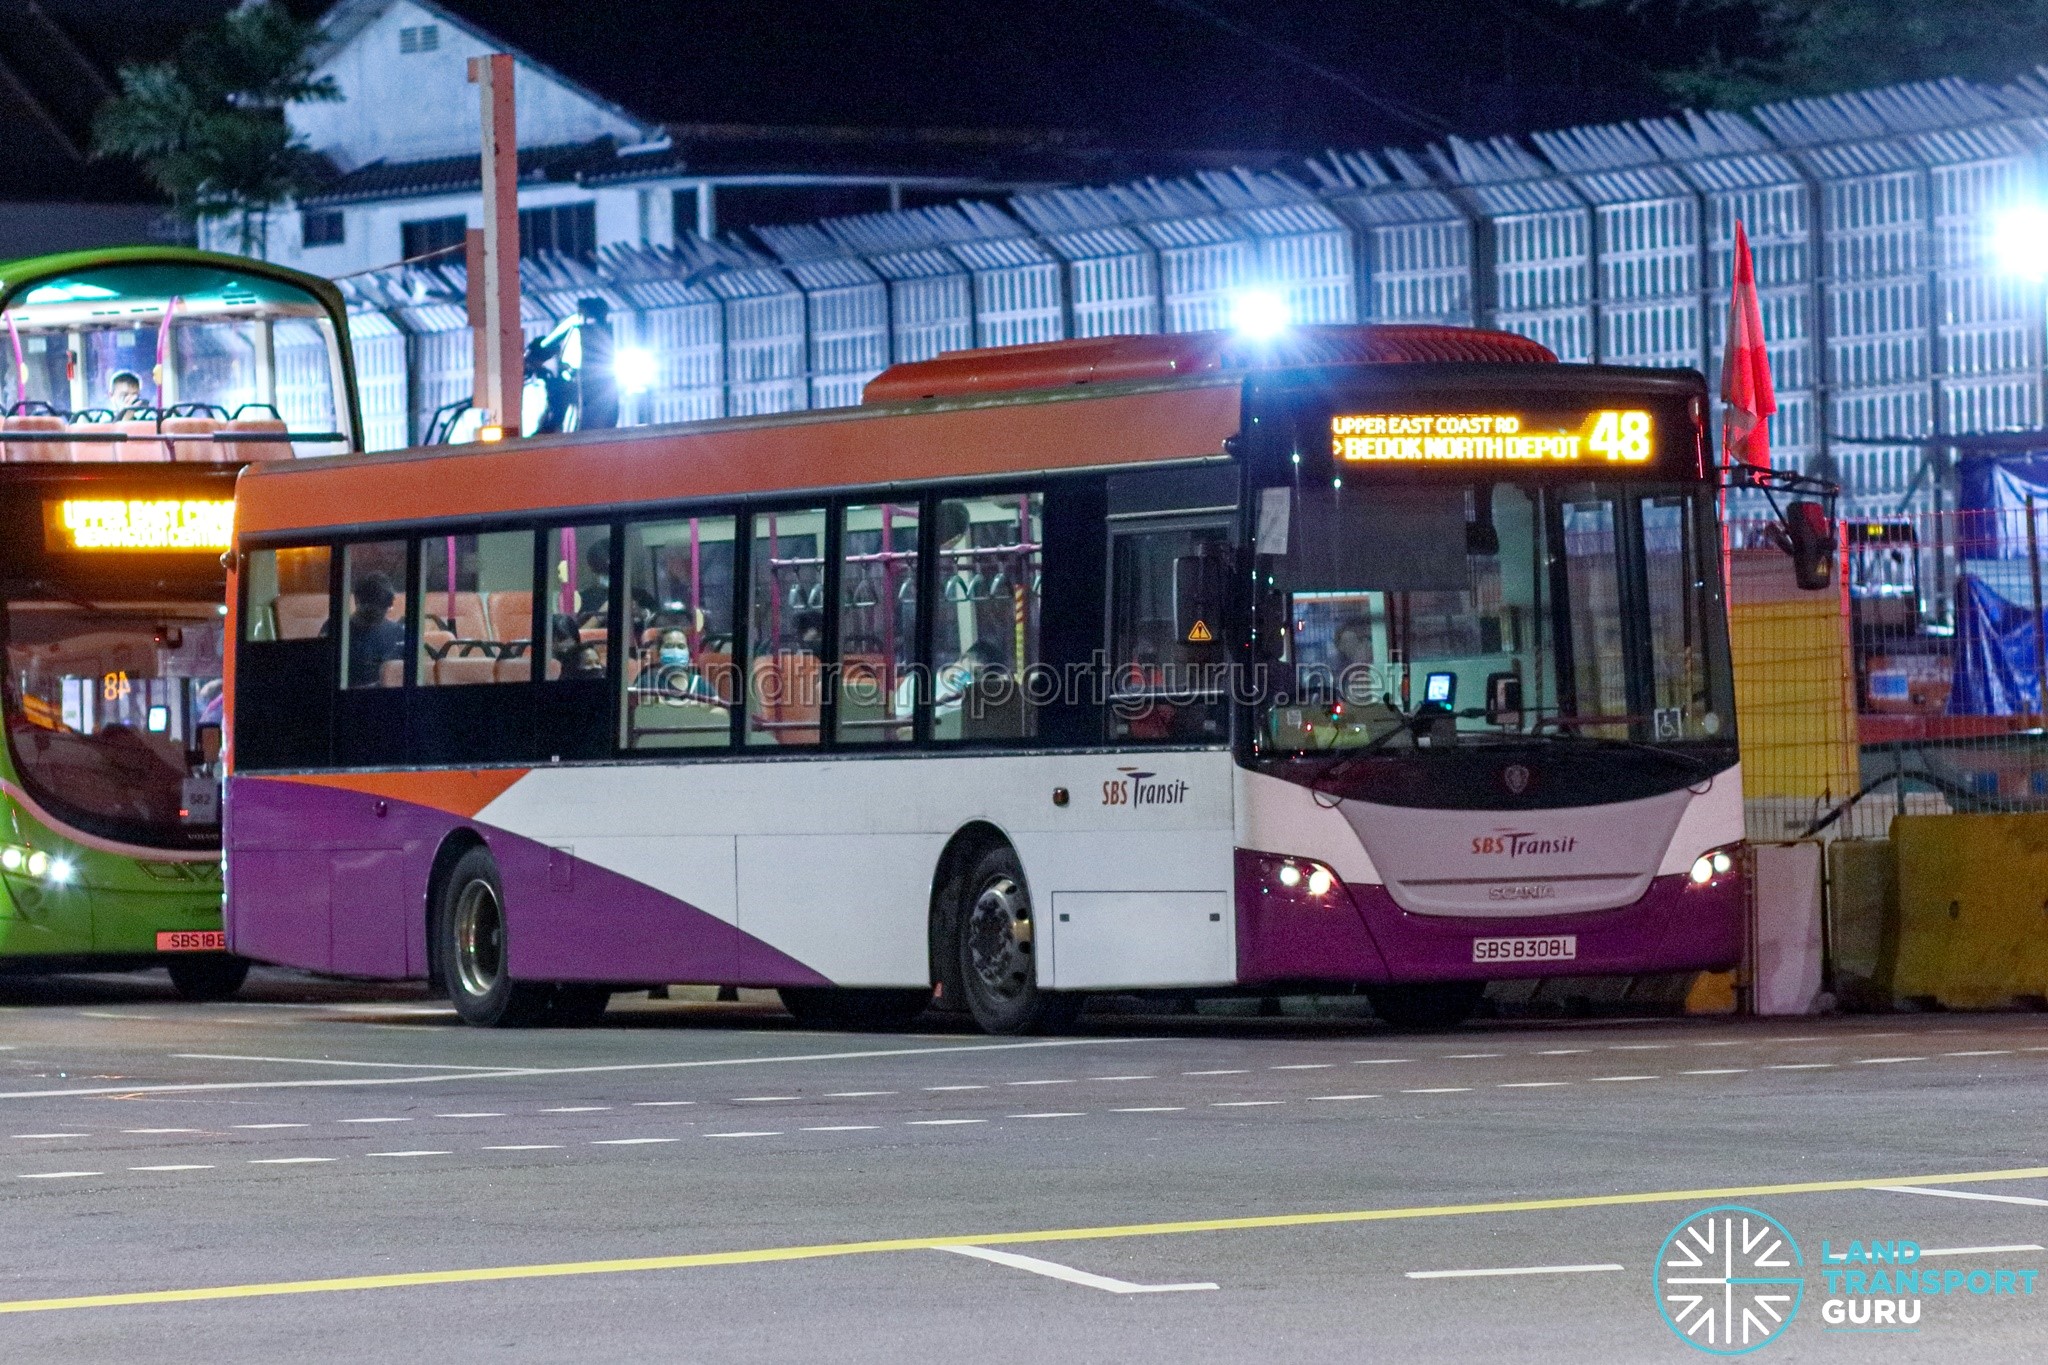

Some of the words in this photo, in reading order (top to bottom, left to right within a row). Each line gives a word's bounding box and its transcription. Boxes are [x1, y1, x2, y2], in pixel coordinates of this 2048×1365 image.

[1332, 416, 1386, 434] UPPER
[1388, 416, 1434, 434] EAST
[1435, 416, 1492, 434] COAST
[1495, 416, 1519, 434] RD
[1589, 411, 1650, 461] 48
[1344, 437, 1423, 459] BEDOK
[1424, 436, 1503, 459] NORTH
[1505, 436, 1581, 459] DEPOT
[1102, 780, 1128, 805] SBS
[1126, 772, 1190, 809] Transit
[1472, 836, 1505, 855] SBS
[1503, 832, 1577, 858] Transit
[1488, 885, 1556, 900] SCANIA
[1475, 939, 1574, 959] SBS8308L
